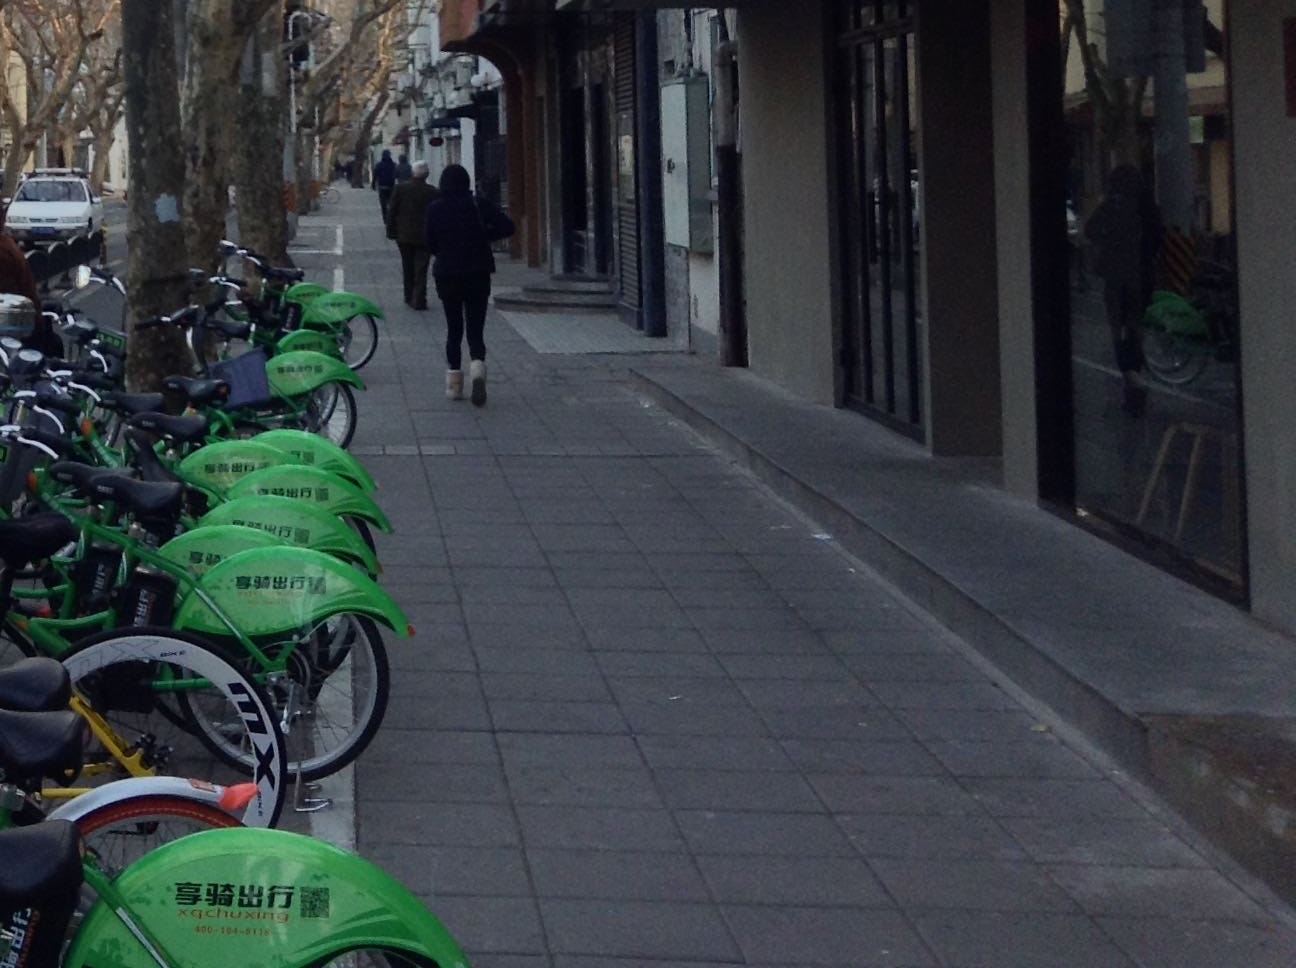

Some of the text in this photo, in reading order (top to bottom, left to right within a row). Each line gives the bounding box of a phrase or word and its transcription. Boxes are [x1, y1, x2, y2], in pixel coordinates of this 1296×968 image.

[235, 575, 305, 590] 享骑出行
[174, 881, 295, 909] 享骑出行
[176, 908, 290, 923] xqchuxing
